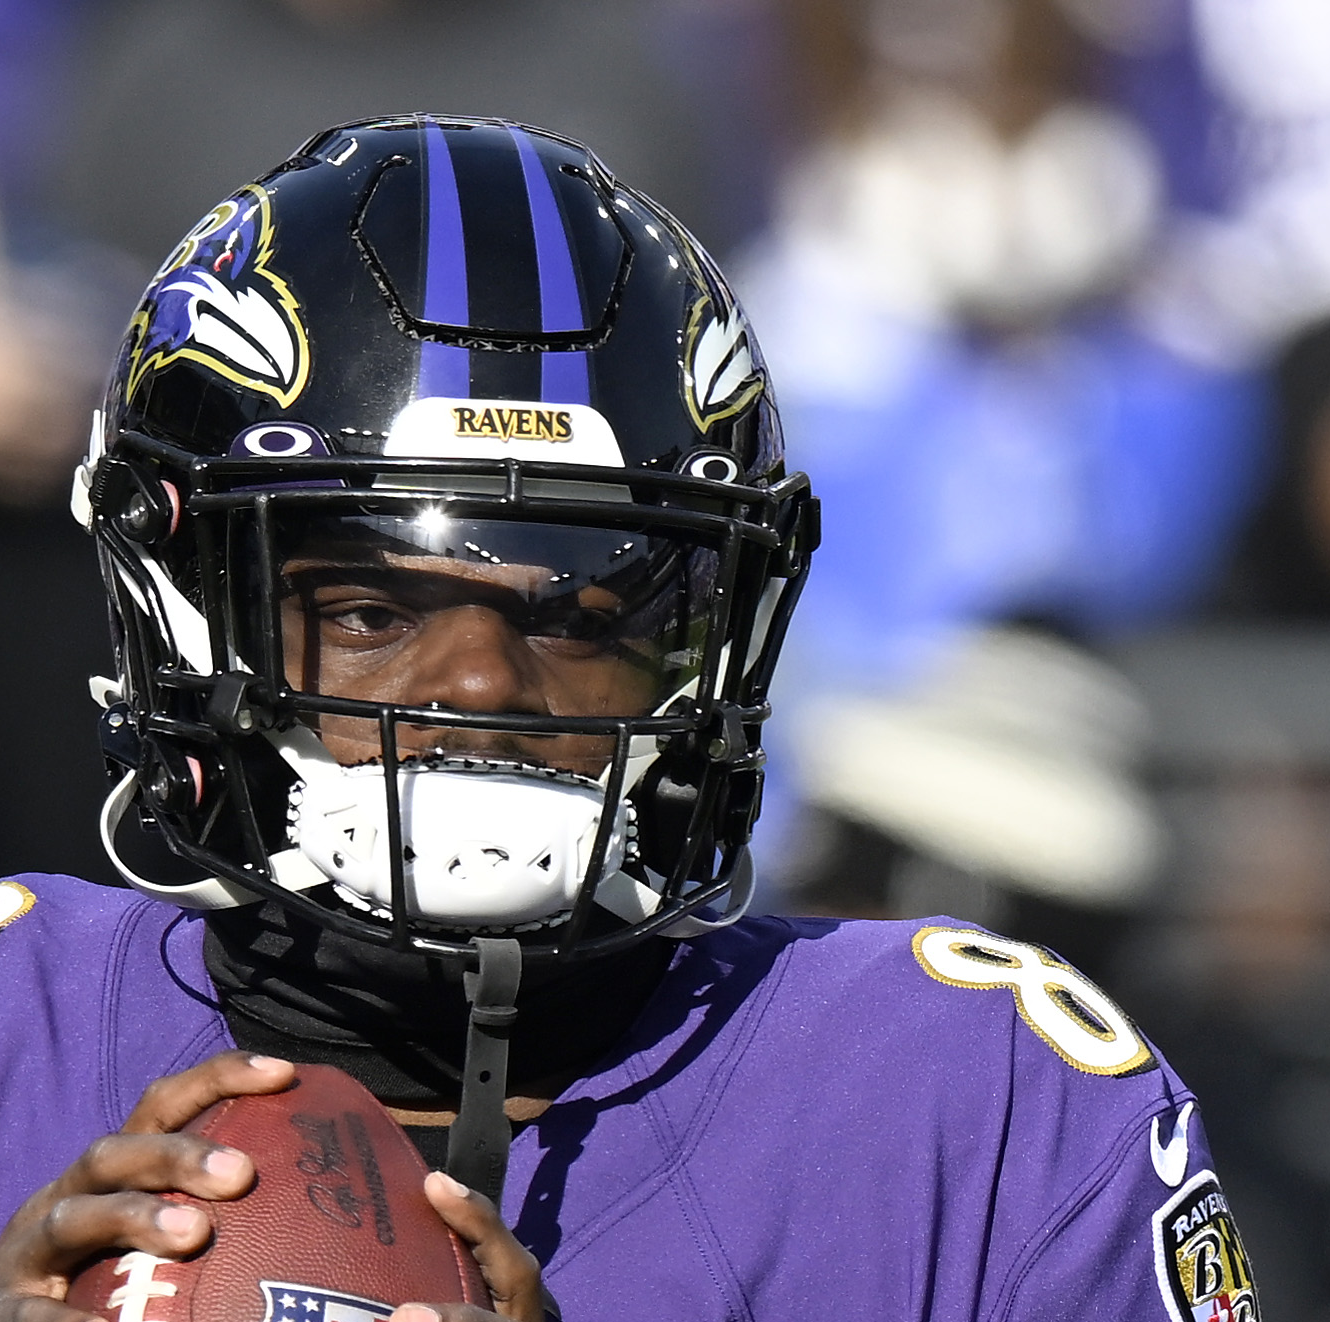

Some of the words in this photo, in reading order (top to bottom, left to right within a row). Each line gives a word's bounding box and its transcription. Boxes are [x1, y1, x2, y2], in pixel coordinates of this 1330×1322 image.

[452, 407, 574, 443] RAVENS
[911, 926, 1160, 1077] 8
[1182, 1229, 1224, 1306] B
